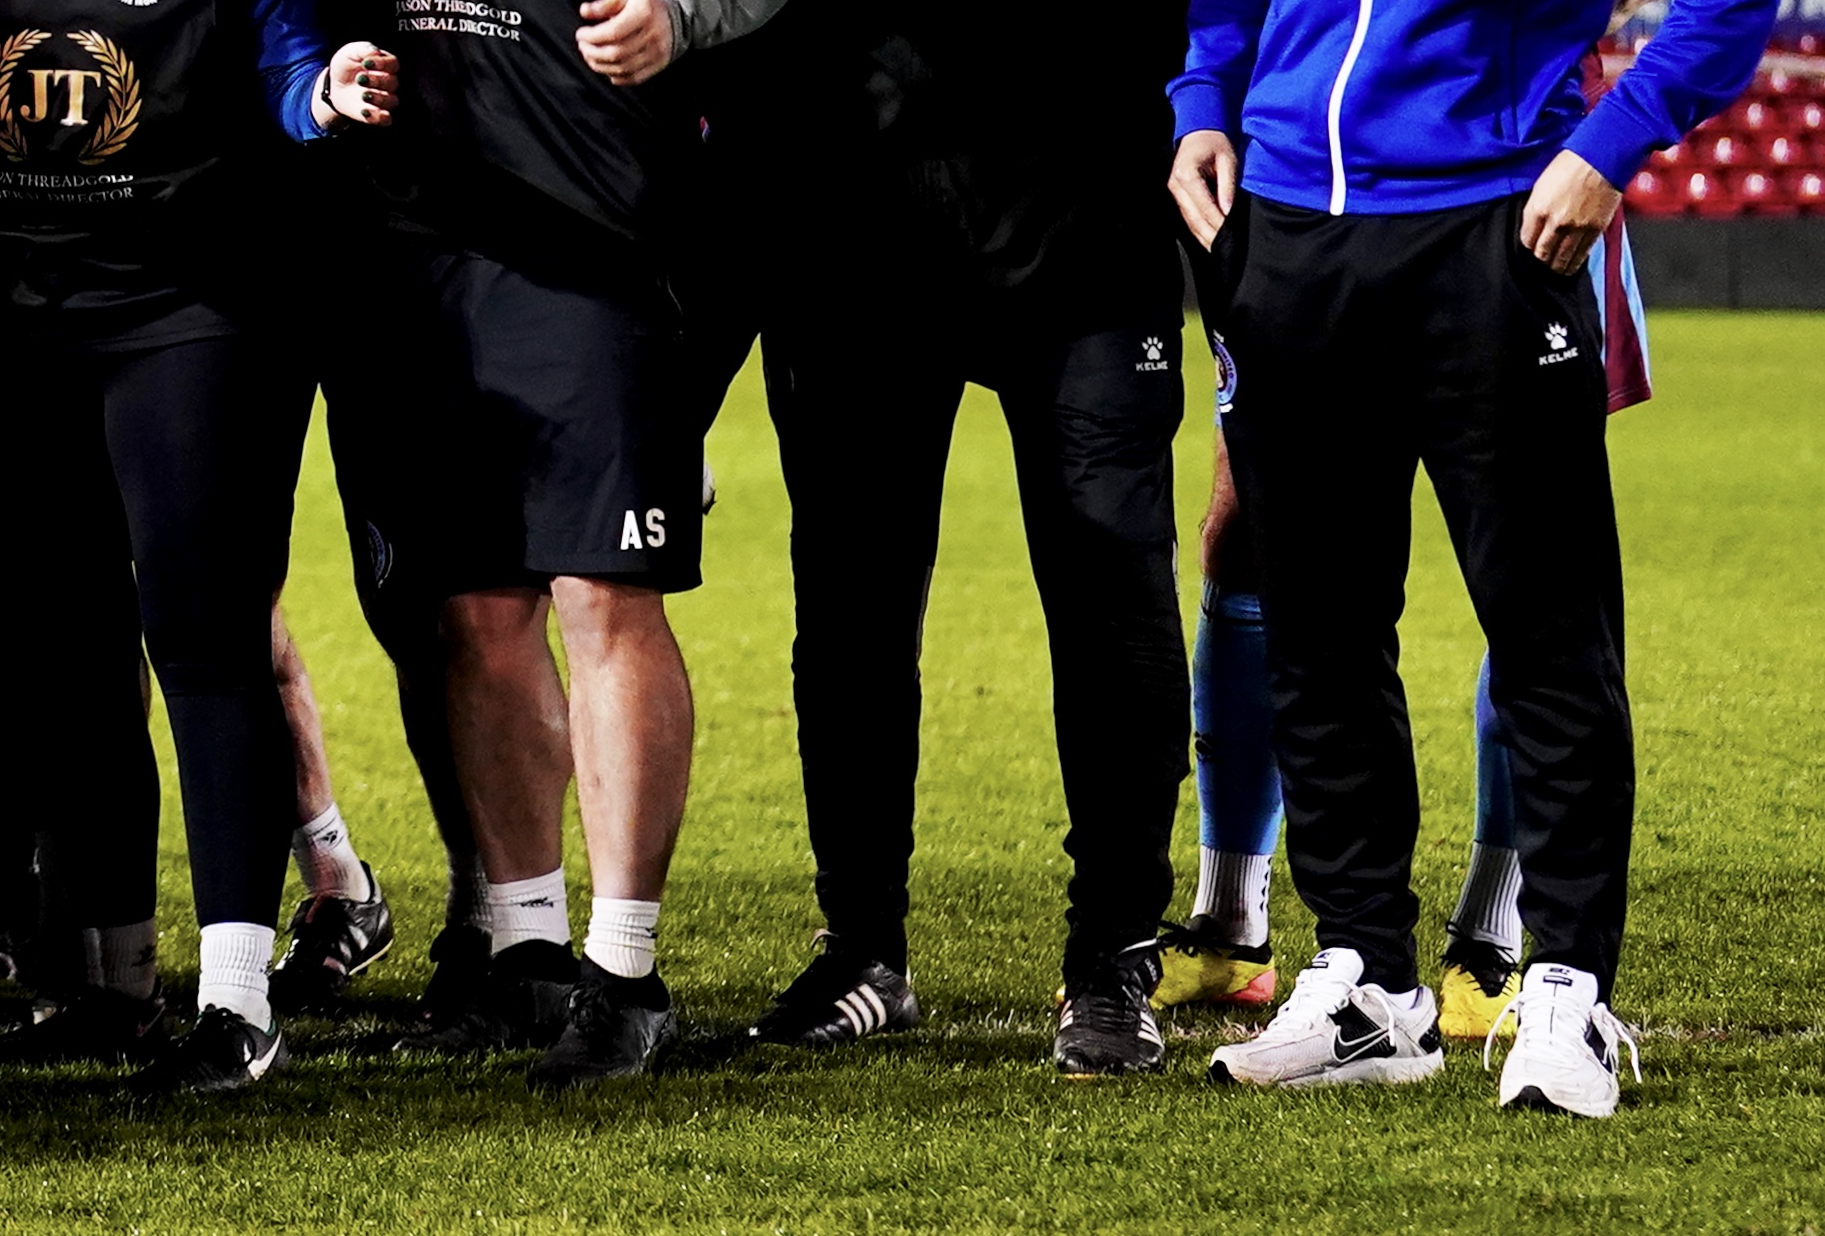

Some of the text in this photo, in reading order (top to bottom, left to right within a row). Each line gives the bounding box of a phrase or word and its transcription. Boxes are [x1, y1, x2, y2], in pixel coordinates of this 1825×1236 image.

[398, 16, 458, 32] FUNERAL
[21, 68, 102, 127] JT
[1539, 346, 1579, 366] KELME
[620, 508, 665, 550] AS
